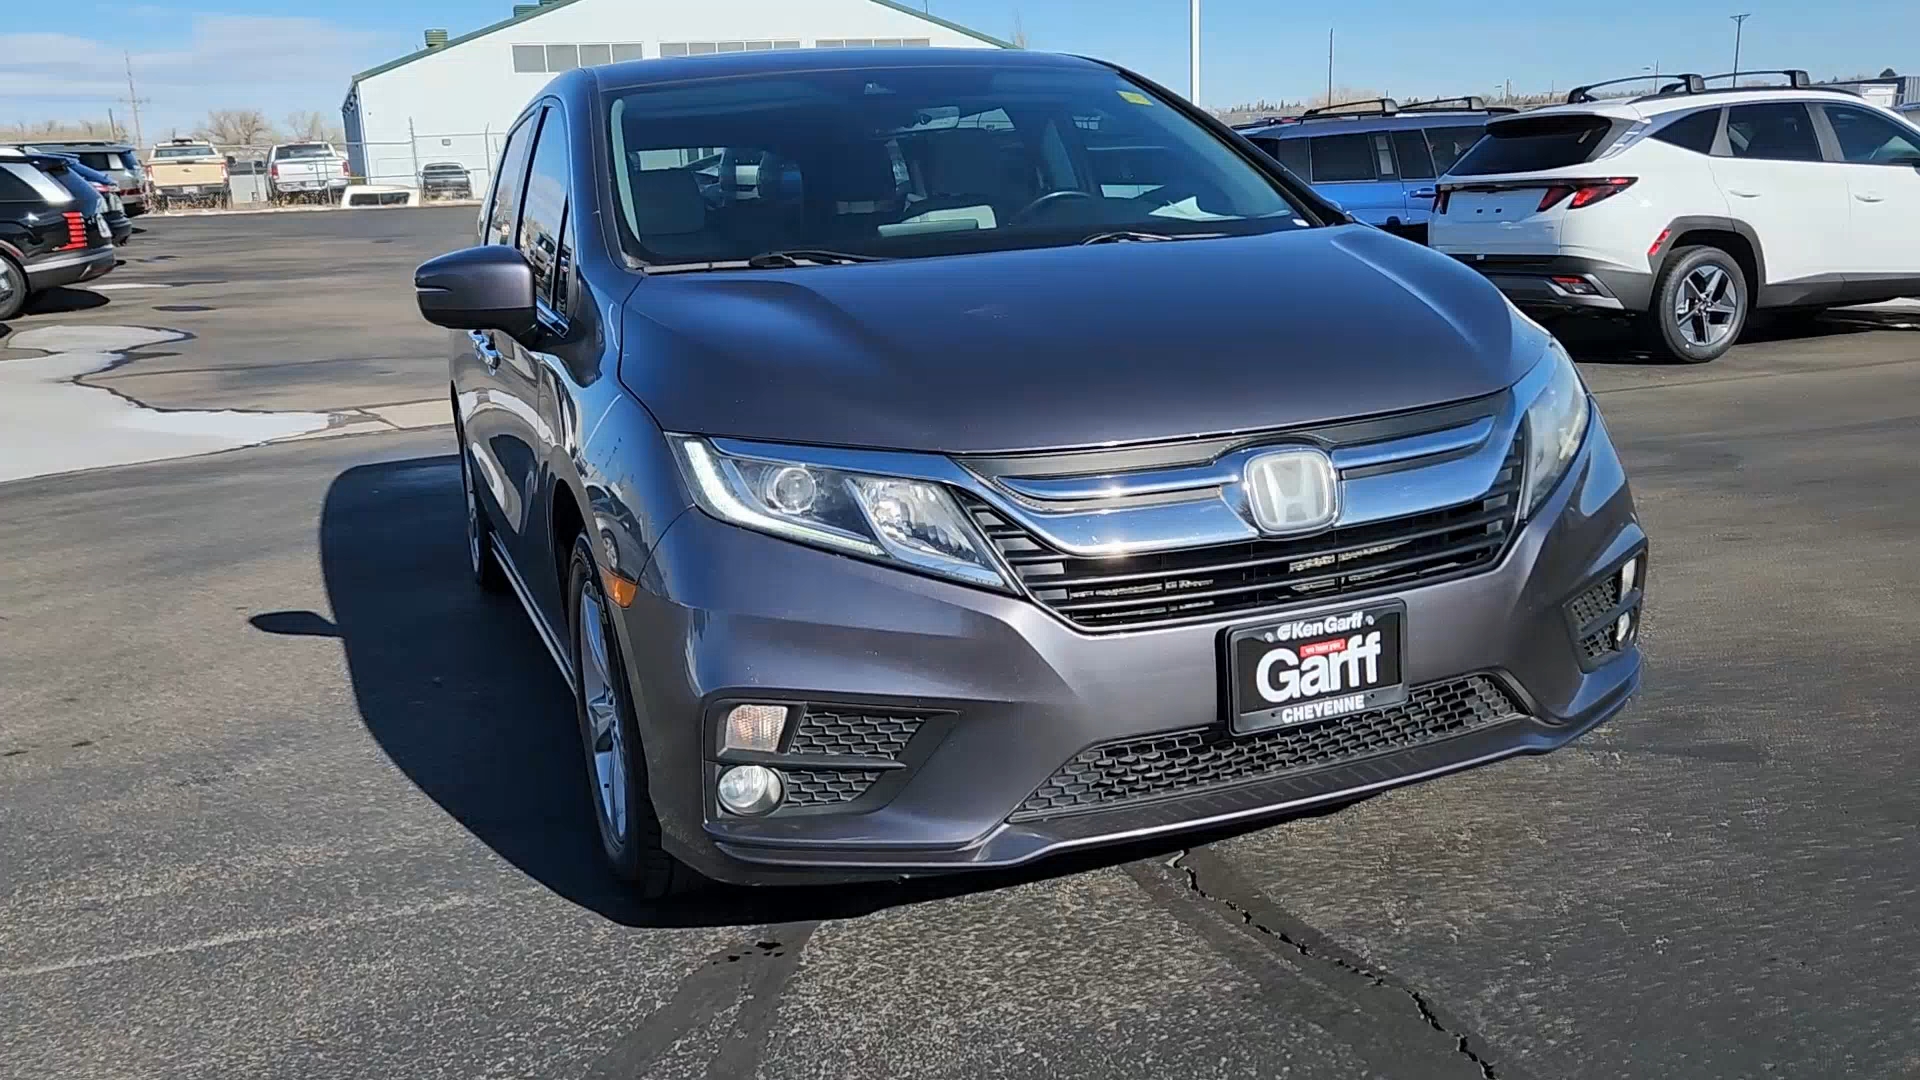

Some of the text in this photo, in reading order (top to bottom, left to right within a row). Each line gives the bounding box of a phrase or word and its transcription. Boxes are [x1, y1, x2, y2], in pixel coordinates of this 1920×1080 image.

[1292, 612, 1363, 639] Ken Garff
[1256, 631, 1381, 703] Garff
[1282, 695, 1365, 723] CHEYENNE
